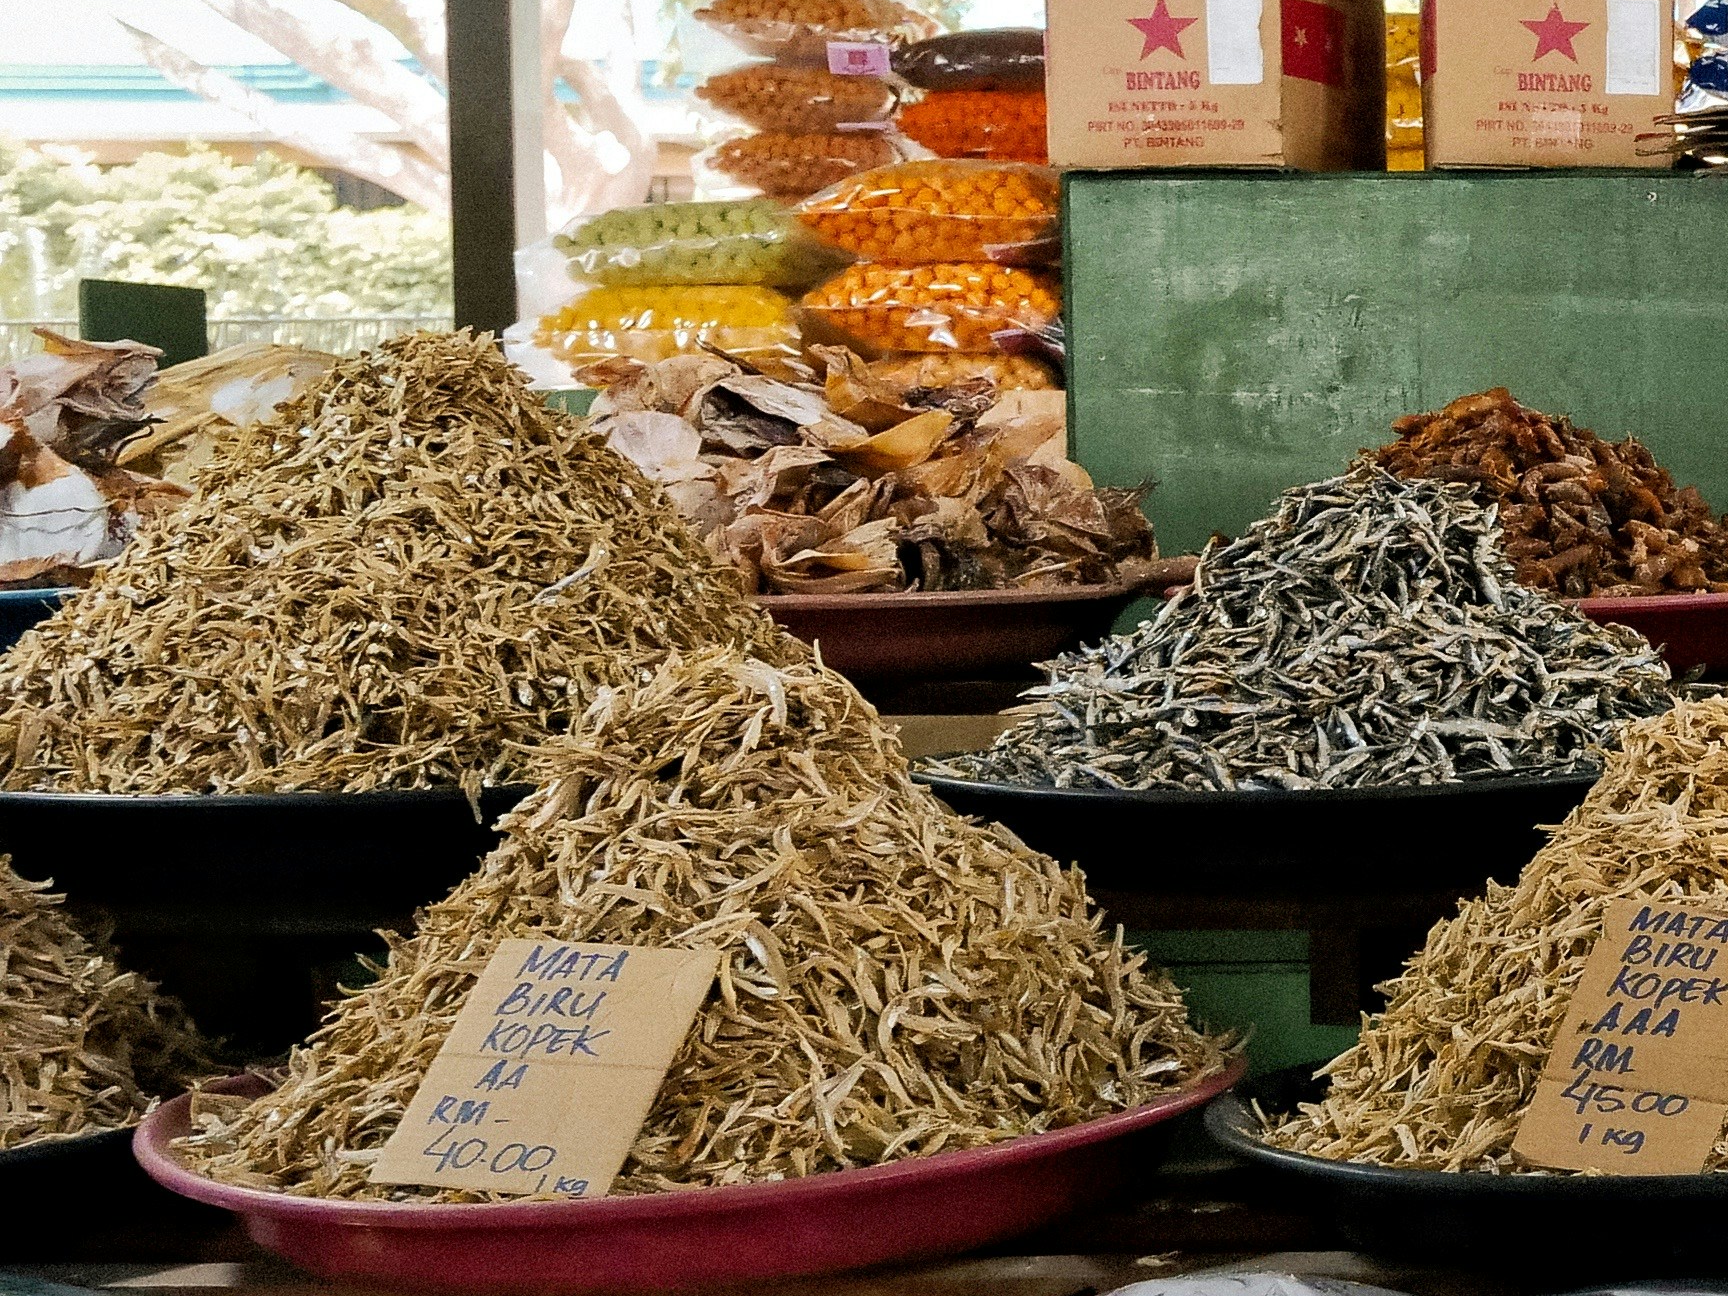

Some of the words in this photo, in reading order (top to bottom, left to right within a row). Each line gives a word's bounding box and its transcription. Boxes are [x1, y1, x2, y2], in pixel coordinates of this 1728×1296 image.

[1126, 71, 1200, 90] BINTANG
[1517, 73, 1592, 92] BINTANG
[516, 945, 630, 982] MATA
[1620, 935, 1718, 971] BIRU
[495, 982, 607, 1020] BIRU
[479, 1019, 611, 1059] KOPEK
[1570, 1038, 1635, 1074] RM
[475, 1059, 529, 1092] AA
